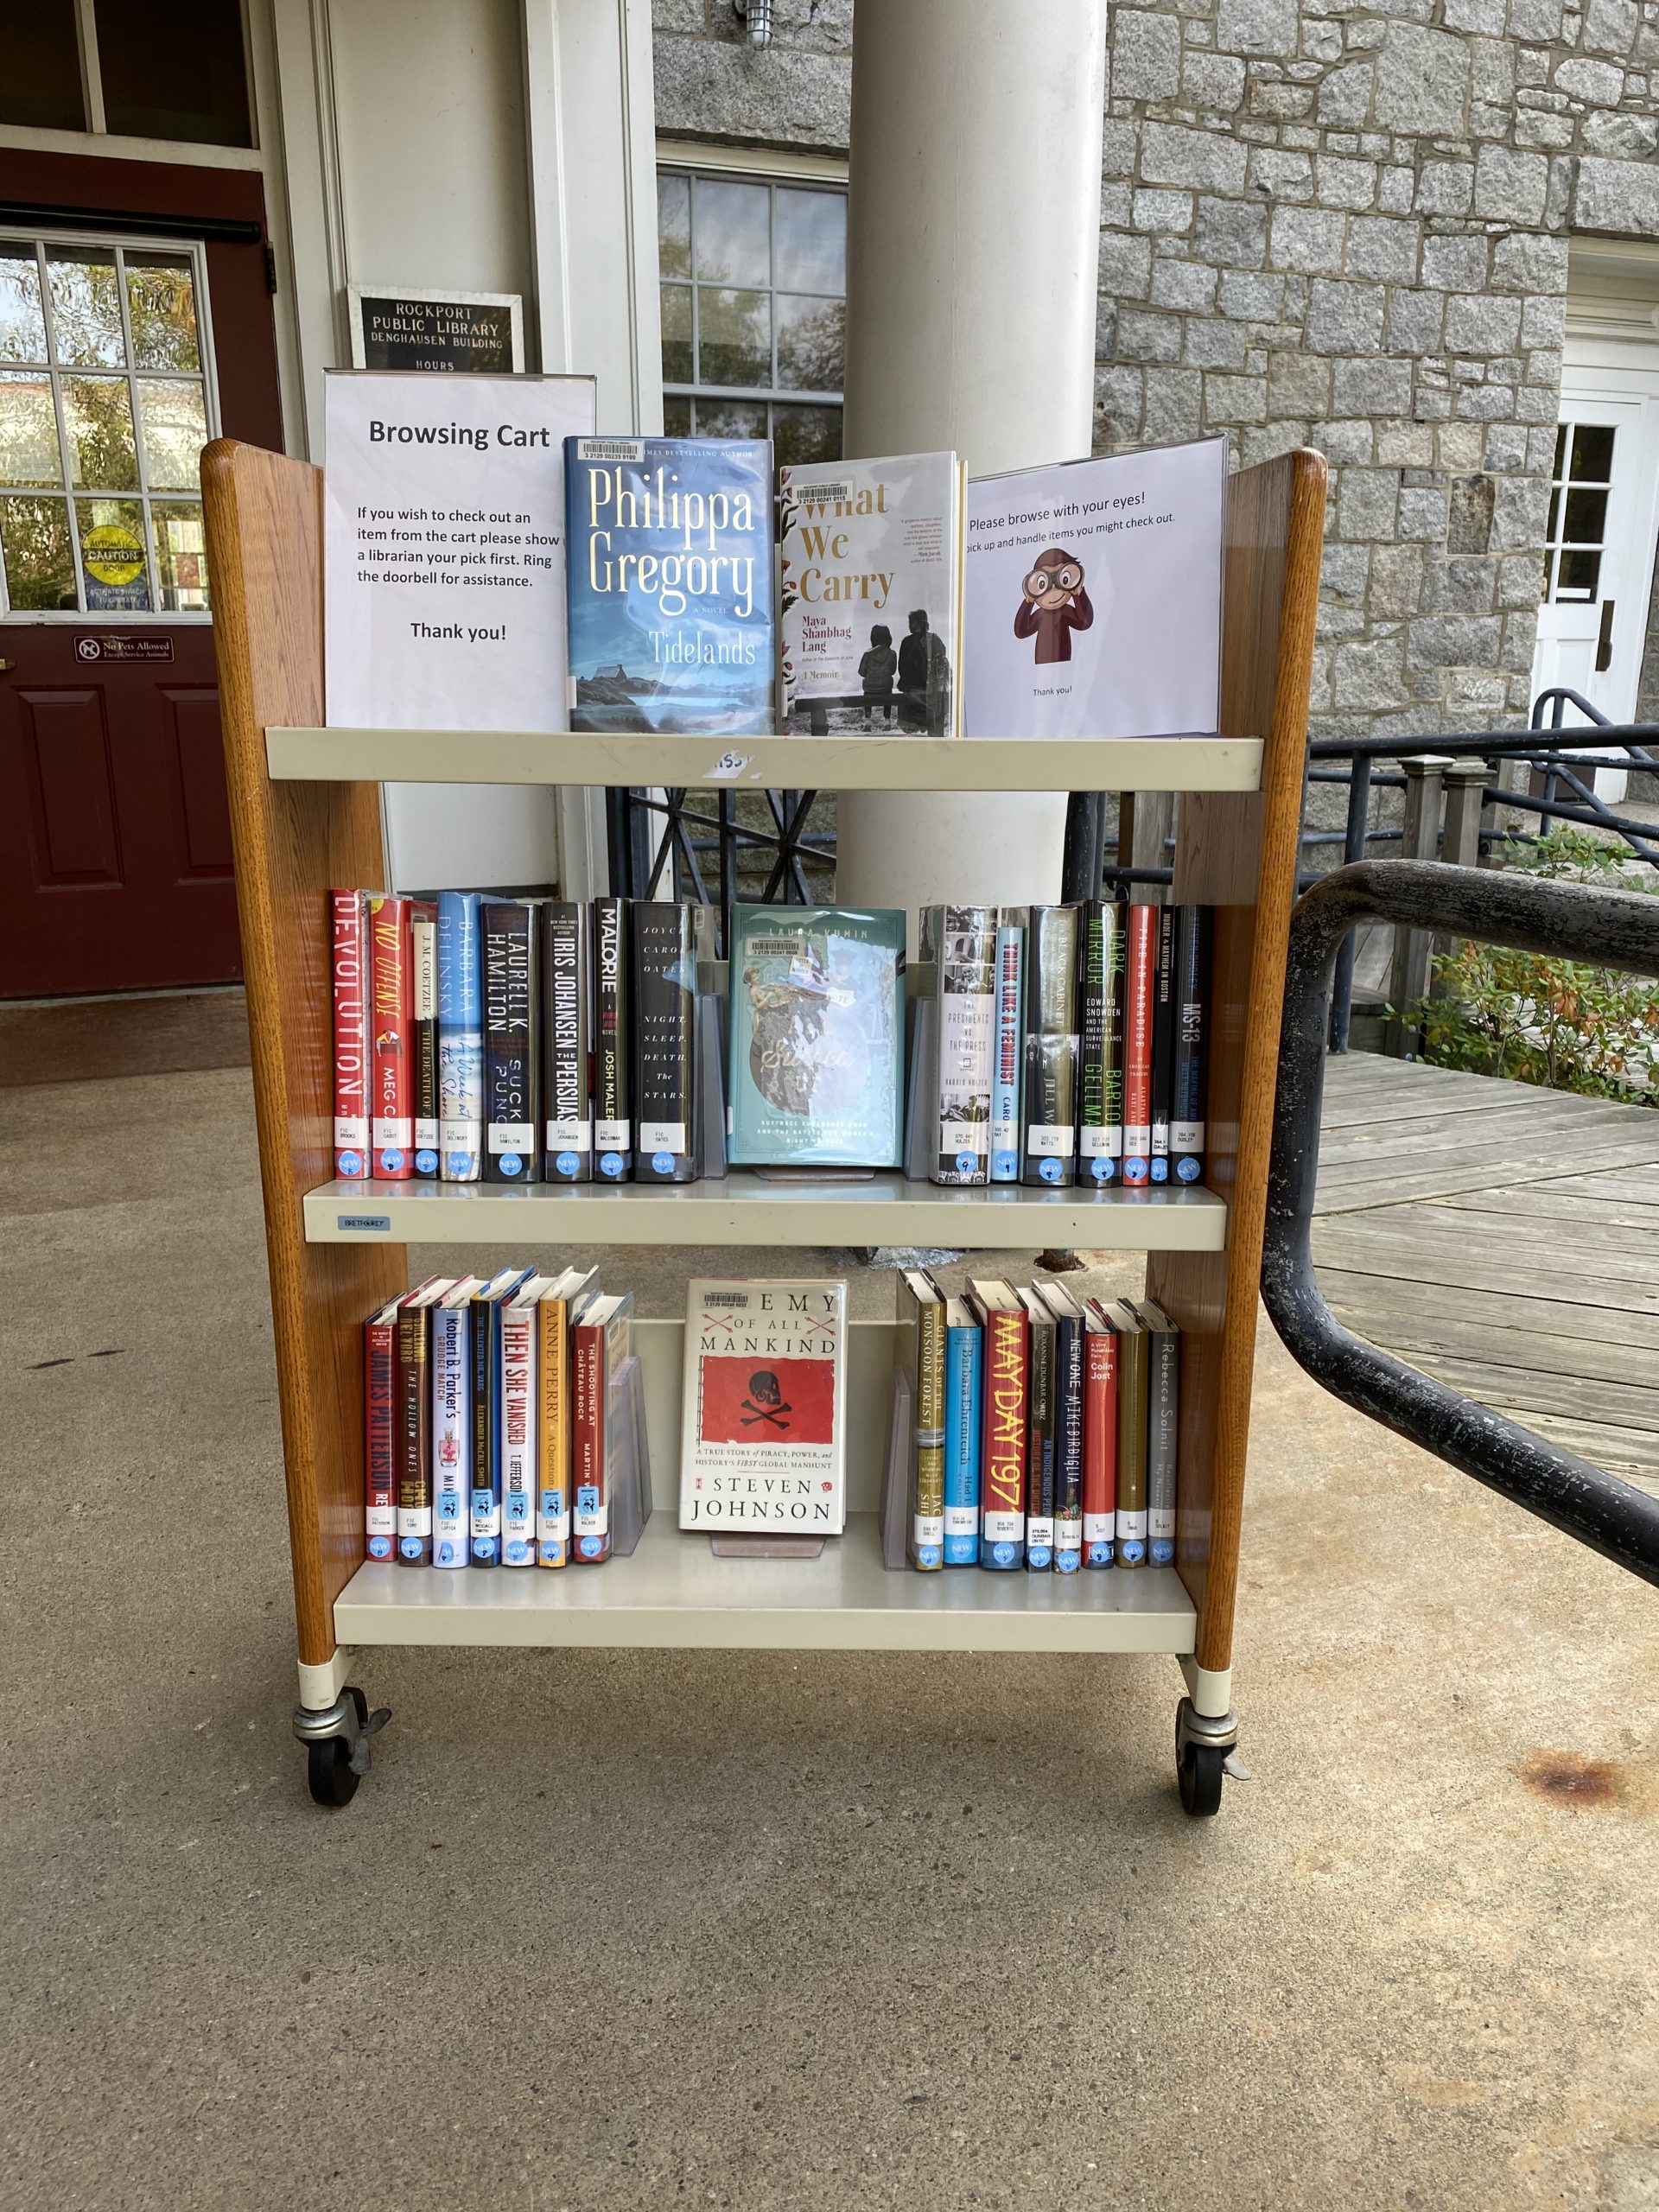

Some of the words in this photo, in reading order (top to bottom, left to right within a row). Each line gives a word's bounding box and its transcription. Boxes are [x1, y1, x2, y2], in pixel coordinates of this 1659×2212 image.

[372, 316, 425, 331] PUBLIC
[436, 321, 499, 336] LIBRARY
[396, 302, 473, 320] ROCKPORT
[371, 332, 446, 346] DENGHAUSEN
[453, 337, 503, 349] BUILDING
[416, 360, 454, 371] HOURS
[370, 421, 489, 450] Browsing
[497, 424, 550, 448] Cart
[357, 506, 366, 519] If
[370, 510, 394, 522] you
[397, 508, 428, 520] wish
[431, 510, 445, 521] to
[448, 510, 486, 523] check
[489, 512, 512, 524] out
[515, 512, 531, 524] an
[588, 466, 755, 551] Philippa
[969, 515, 1005, 532] Please
[1007, 508, 1050, 525] browse
[1053, 503, 1079, 518] with
[1082, 499, 1109, 515] your
[1112, 491, 1146, 509] eyes!
[357, 528, 387, 540] item
[391, 529, 422, 541] from
[425, 530, 448, 542] the
[450, 531, 476, 543] cart
[480, 531, 522, 546] please
[524, 533, 560, 546] show
[799, 525, 849, 562] We
[984, 542, 995, 551] up
[997, 537, 1014, 549] and
[1016, 532, 1046, 546] handle
[1048, 528, 1074, 541] items
[1077, 526, 1093, 538] you
[1096, 520, 1123, 534] might
[1125, 515, 1154, 529] check
[1156, 512, 1175, 524] out.
[87, 550, 137, 561] CAUTION
[357, 552, 365, 561] a
[368, 549, 423, 563] librarian
[427, 553, 457, 565] your
[460, 552, 486, 567] pick
[490, 553, 519, 565] first.
[524, 554, 552, 569] Ring
[357, 570, 379, 582] the
[383, 570, 437, 584] doorbell
[441, 572, 460, 585] for
[463, 574, 533, 587] assistance.
[588, 531, 756, 618] Gregory
[800, 568, 896, 609] Carry
[410, 622, 463, 639] Thank
[467, 625, 506, 642] you!
[802, 616, 826, 629] Maya
[802, 626, 852, 639] Shanbhag
[103, 642, 117, 651] No
[118, 642, 135, 651] Pets
[137, 642, 169, 651] Allowed
[649, 630, 756, 664] Tidelands
[802, 641, 826, 653] Lang
[1033, 687, 1055, 696] Thank
[1056, 685, 1072, 696] you!
[375, 921, 401, 951] NO
[554, 938, 576, 967] IRIS
[601, 909, 618, 994] MALORIE
[1087, 919, 1104, 984] MIRROR
[1109, 931, 1125, 973] DARK
[1139, 929, 1147, 957] FIRE
[438, 916, 452, 1019] DELINSKY
[458, 921, 474, 1013] BARBARA
[508, 933, 527, 1011] LAURELL
[1003, 943, 1018, 982] THINK
[375, 957, 403, 1020] OFFENSE
[423, 961, 431, 1011] COETZEE
[487, 934, 507, 1031] HAMILTON
[1002, 985, 1017, 1013] LIKE
[508, 1018, 528, 1033] K.
[554, 971, 577, 1048] JOHANSEN
[1135, 987, 1146, 1048] PARADISE
[1182, 1003, 1202, 1042] MS-13
[423, 1030, 431, 1053] THE
[1001, 1029, 1016, 1087] FEMINIST
[423, 1056, 431, 1093] DEATH
[606, 1050, 615, 1079] JOSH
[384, 1067, 396, 1100] MEG
[495, 1065, 508, 1124] PUNC
[509, 1059, 521, 1120] SUCK
[1044, 1077, 1055, 1105] JILL
[446, 1318, 462, 1355] Robert
[504, 1320, 529, 1363] THEN
[546, 1308, 558, 1359] ANNE
[734, 1319, 755, 1328] OF
[768, 1320, 801, 1330] ALL
[923, 1311, 933, 1373] MONSOON
[437, 1336, 446, 1370] GRUDGE
[700, 1337, 836, 1353] MANKIND
[936, 1325, 944, 1373] GIANTS
[1070, 1339, 1081, 1362] NEW
[371, 1349, 393, 1402] JAMES
[408, 1370, 417, 1388] THE
[446, 1359, 461, 1370] B.
[505, 1369, 528, 1394] SHE
[577, 1350, 586, 1392] CHÂTEAU
[961, 1349, 973, 1396] Barbara
[1070, 1364, 1081, 1388] ONE
[1161, 1344, 1174, 1402] Rebecca
[437, 1372, 446, 1401] MATCH
[446, 1373, 461, 1419] Parker's
[546, 1368, 558, 1422] PERRY
[922, 1378, 931, 1426] FOREST
[408, 1397, 416, 1438] HOLLOW
[506, 1397, 526, 1445] VANISHED
[588, 1415, 595, 1427] AT
[1065, 1395, 1081, 1427] MIKE
[371, 1406, 394, 1491] PATTERSON
[960, 1400, 972, 1465] Ehrenreich
[1160, 1410, 1173, 1450] Solnit
[409, 1446, 417, 1472] ONES
[1043, 1452, 1052, 1496] INDIGENOUS
[1064, 1431, 1080, 1483] BIRBIGLIA
[713, 1478, 811, 1494] STEVEN
[691, 1499, 830, 1521] JOHNSON
